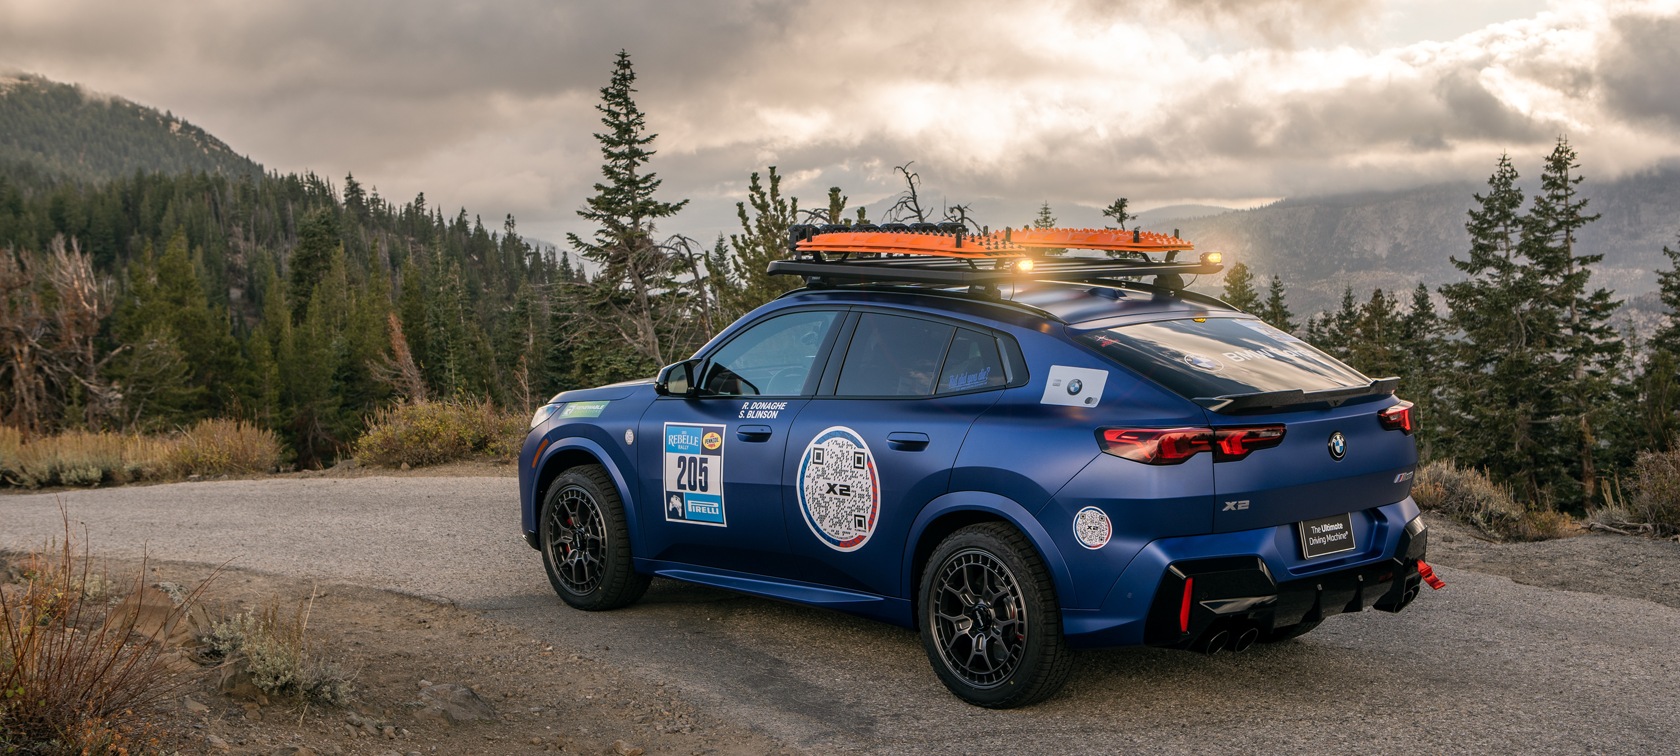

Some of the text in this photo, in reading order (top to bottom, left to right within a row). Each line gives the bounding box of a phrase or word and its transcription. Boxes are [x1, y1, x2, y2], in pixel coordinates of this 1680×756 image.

[741, 402, 788, 410] R. DONAGHE
[738, 411, 779, 419] S. BLINSON
[668, 434, 699, 447] REBELLE
[677, 456, 708, 492] 205
[826, 483, 851, 497] X2
[687, 500, 719, 515] PIRELLI
[1222, 500, 1250, 511] X2
[1311, 523, 1344, 534] The Ultimate
[1309, 536, 1326, 546] Driving
